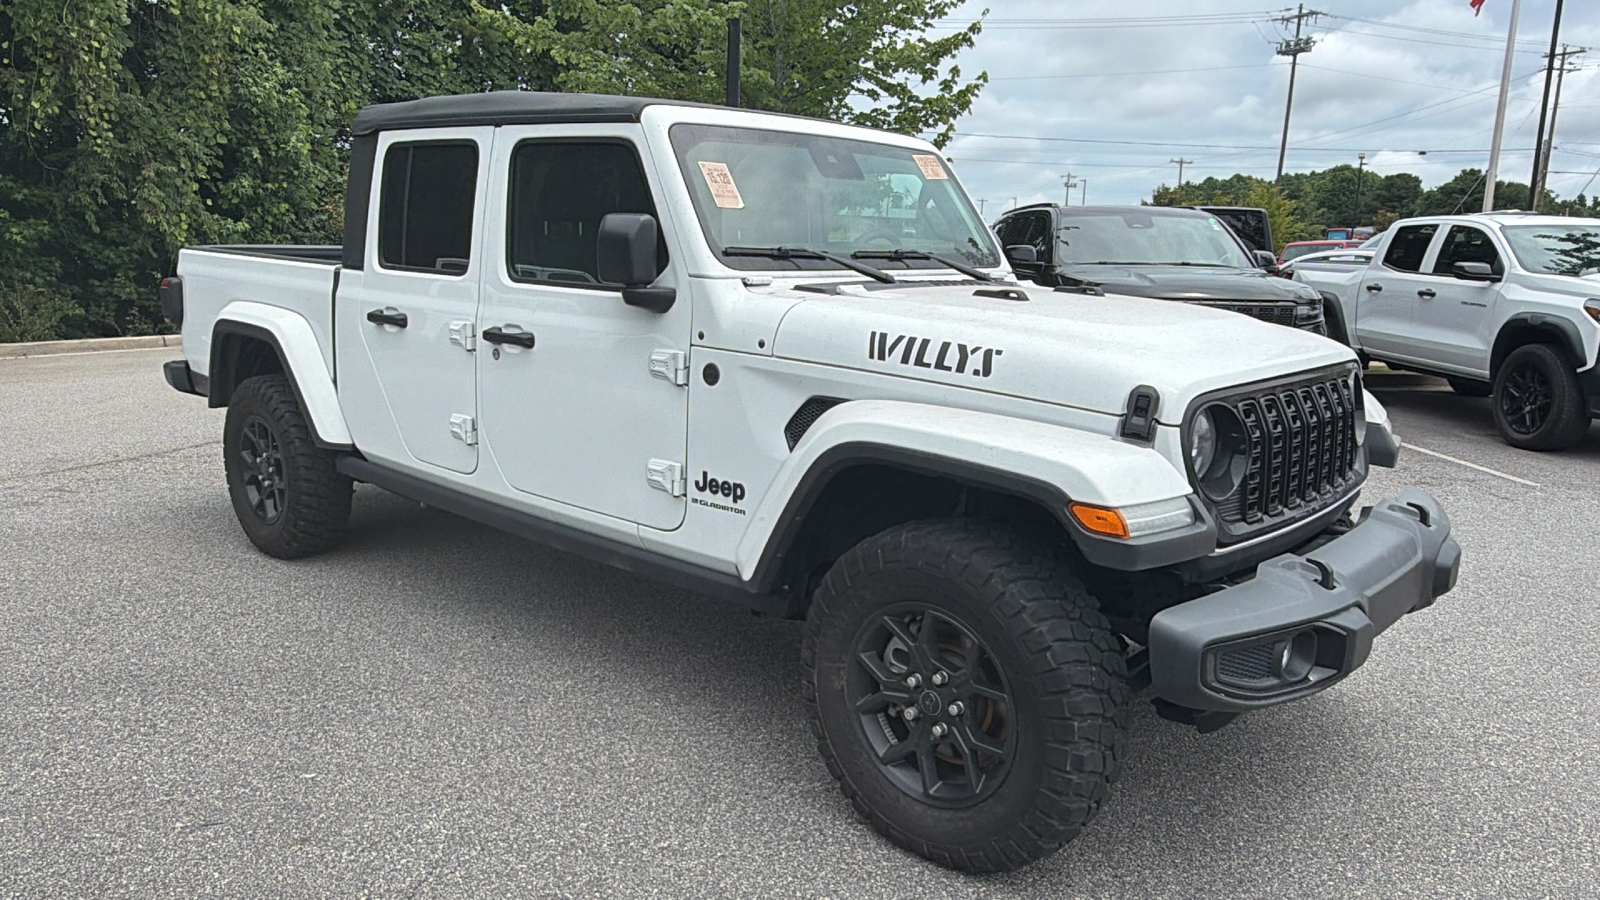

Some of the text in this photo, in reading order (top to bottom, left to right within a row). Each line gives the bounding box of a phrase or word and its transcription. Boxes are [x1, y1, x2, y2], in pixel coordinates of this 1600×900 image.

[868, 330, 1004, 378] WILLYS
[694, 470, 746, 504] Jeep
[699, 499, 747, 516] GLADIATOR
